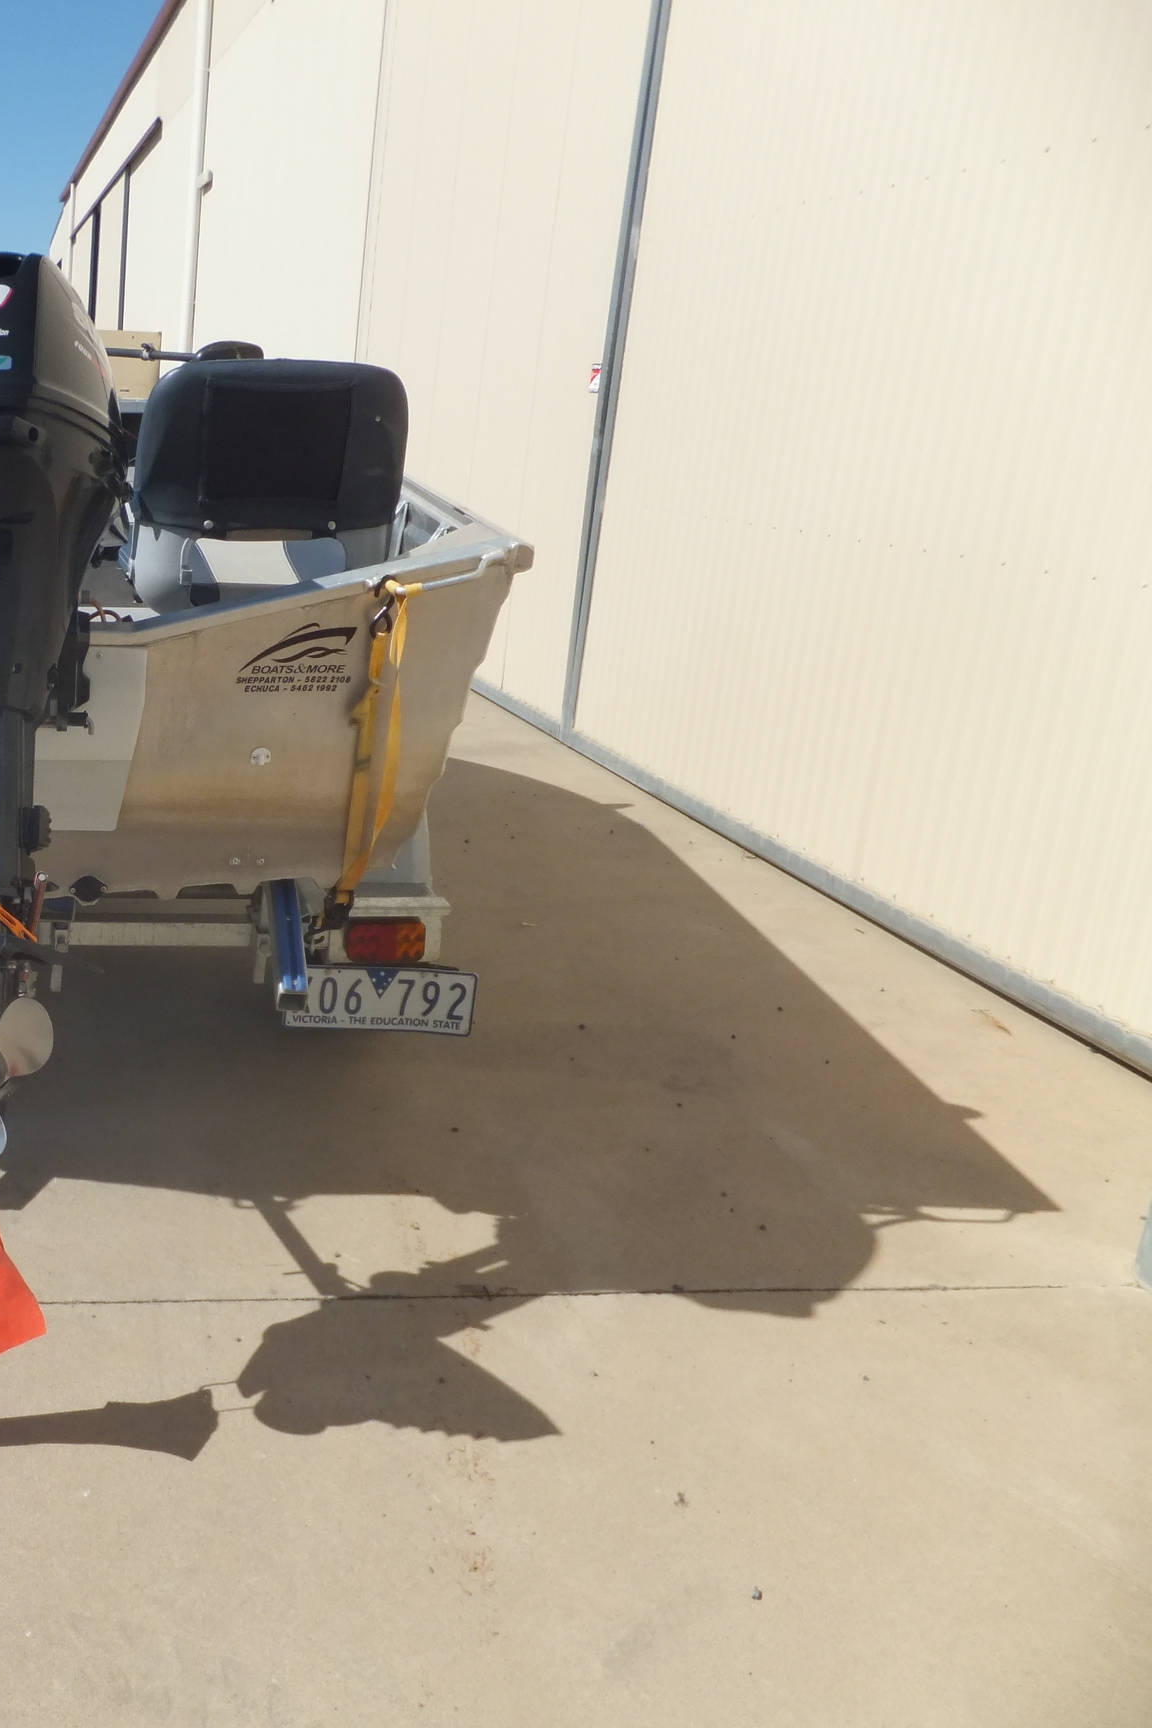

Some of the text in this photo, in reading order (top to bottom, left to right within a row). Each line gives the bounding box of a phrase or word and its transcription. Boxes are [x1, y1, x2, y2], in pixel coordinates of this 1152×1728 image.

[251, 663, 346, 675] BOATS&MORE
[236, 676, 295, 684] SHEPPARTON
[304, 675, 328, 683] 5822
[244, 685, 280, 693] ECHUCA
[398, 979, 467, 1021] 792
[292, 1015, 338, 1025] VICTORIA
[349, 1016, 367, 1025] THE
[370, 1017, 429, 1028] EDUCATION
[432, 1020, 461, 1031] STATE
